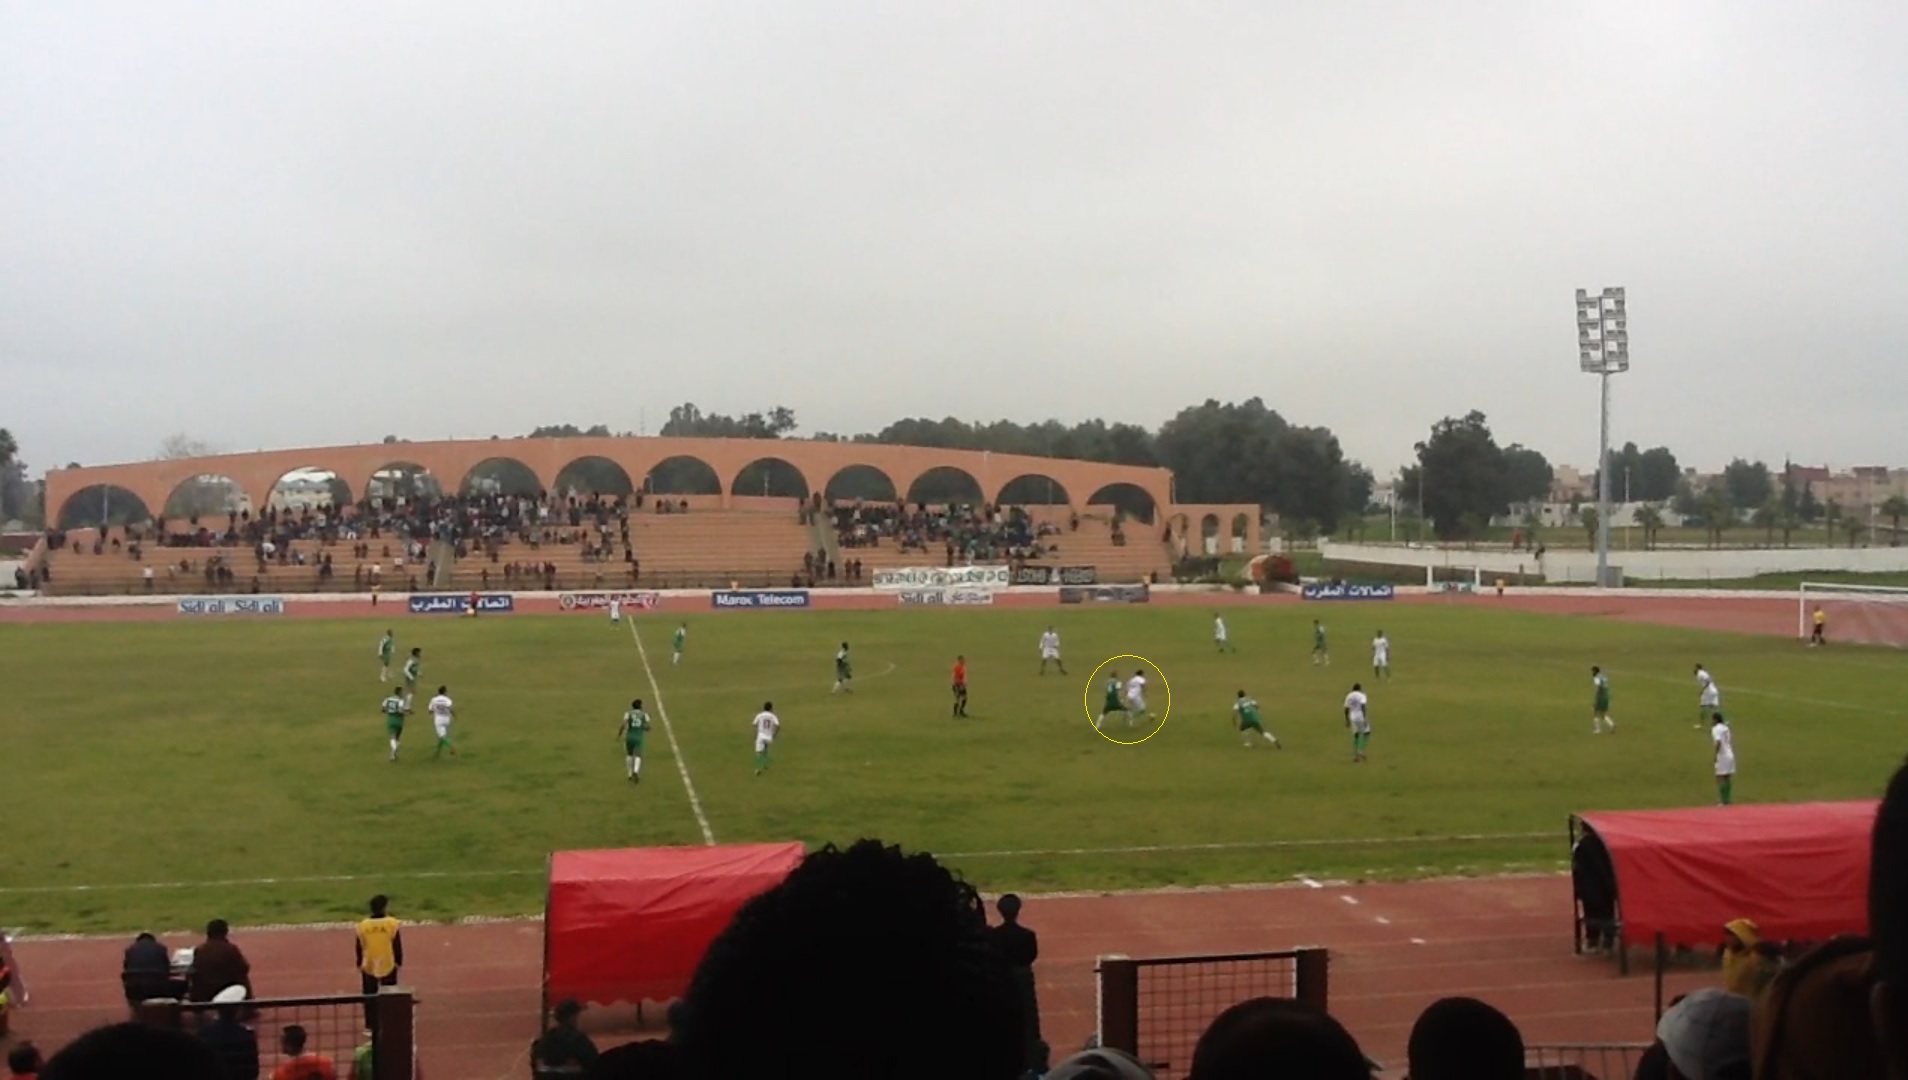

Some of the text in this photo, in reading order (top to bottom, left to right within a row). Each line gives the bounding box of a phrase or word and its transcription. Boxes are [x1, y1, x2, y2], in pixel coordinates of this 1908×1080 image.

[1305, 585, 1391, 598] اتصالات المغرب
[181, 599, 205, 612] Sidi
[235, 599, 259, 612] Sidi
[411, 597, 456, 611] المغرب
[716, 593, 805, 605] Maroc Telecom
